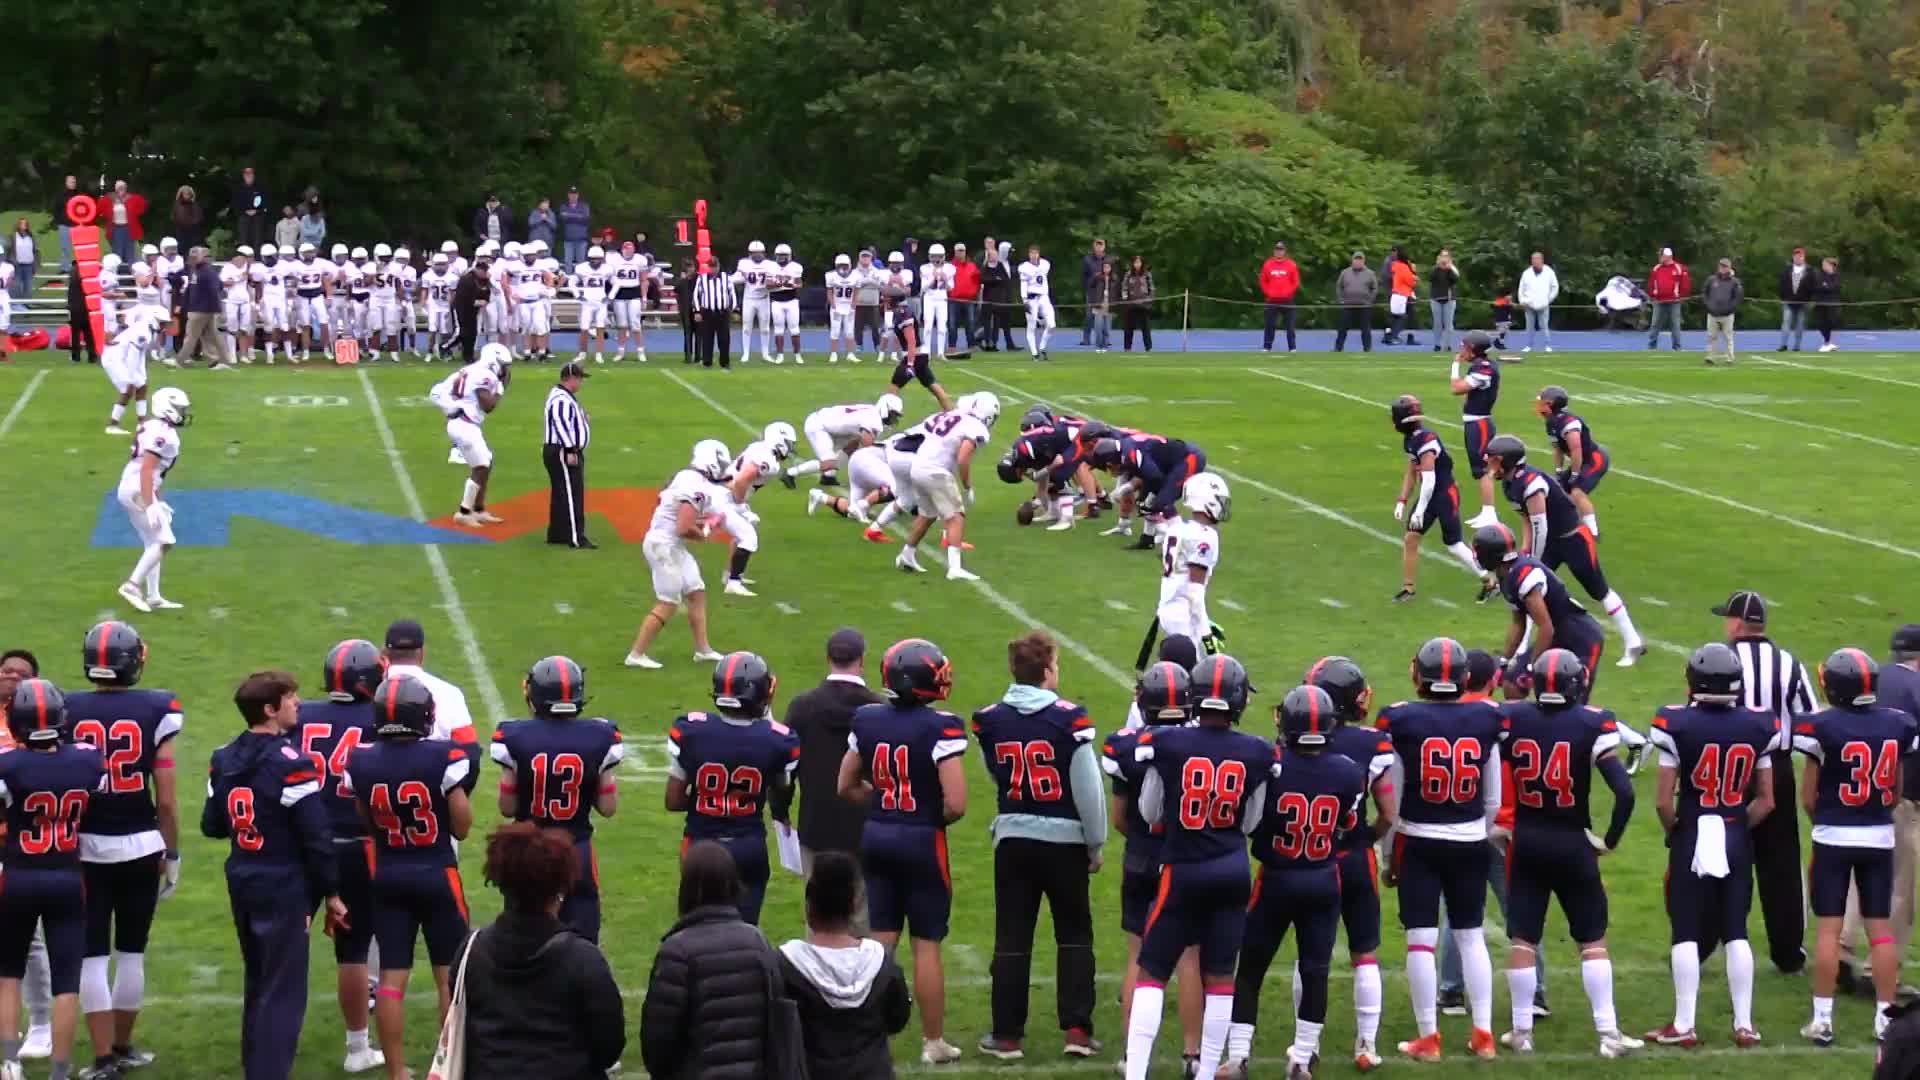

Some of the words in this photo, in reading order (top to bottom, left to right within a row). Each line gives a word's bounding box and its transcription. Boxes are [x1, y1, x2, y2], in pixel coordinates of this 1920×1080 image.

[302, 723, 364, 798] 54
[529, 753, 584, 821] 13
[696, 763, 763, 818] 82
[872, 743, 917, 812] 41
[996, 740, 1063, 801] 76
[1179, 757, 1247, 830] 88
[1420, 737, 1482, 803] 66
[1512, 738, 1575, 809] 24
[1691, 743, 1756, 808] 40
[1838, 740, 1899, 806] 34
[19, 790, 90, 855] 30
[227, 787, 264, 851] 8
[369, 781, 439, 849] 43
[1273, 792, 1340, 862] 38
